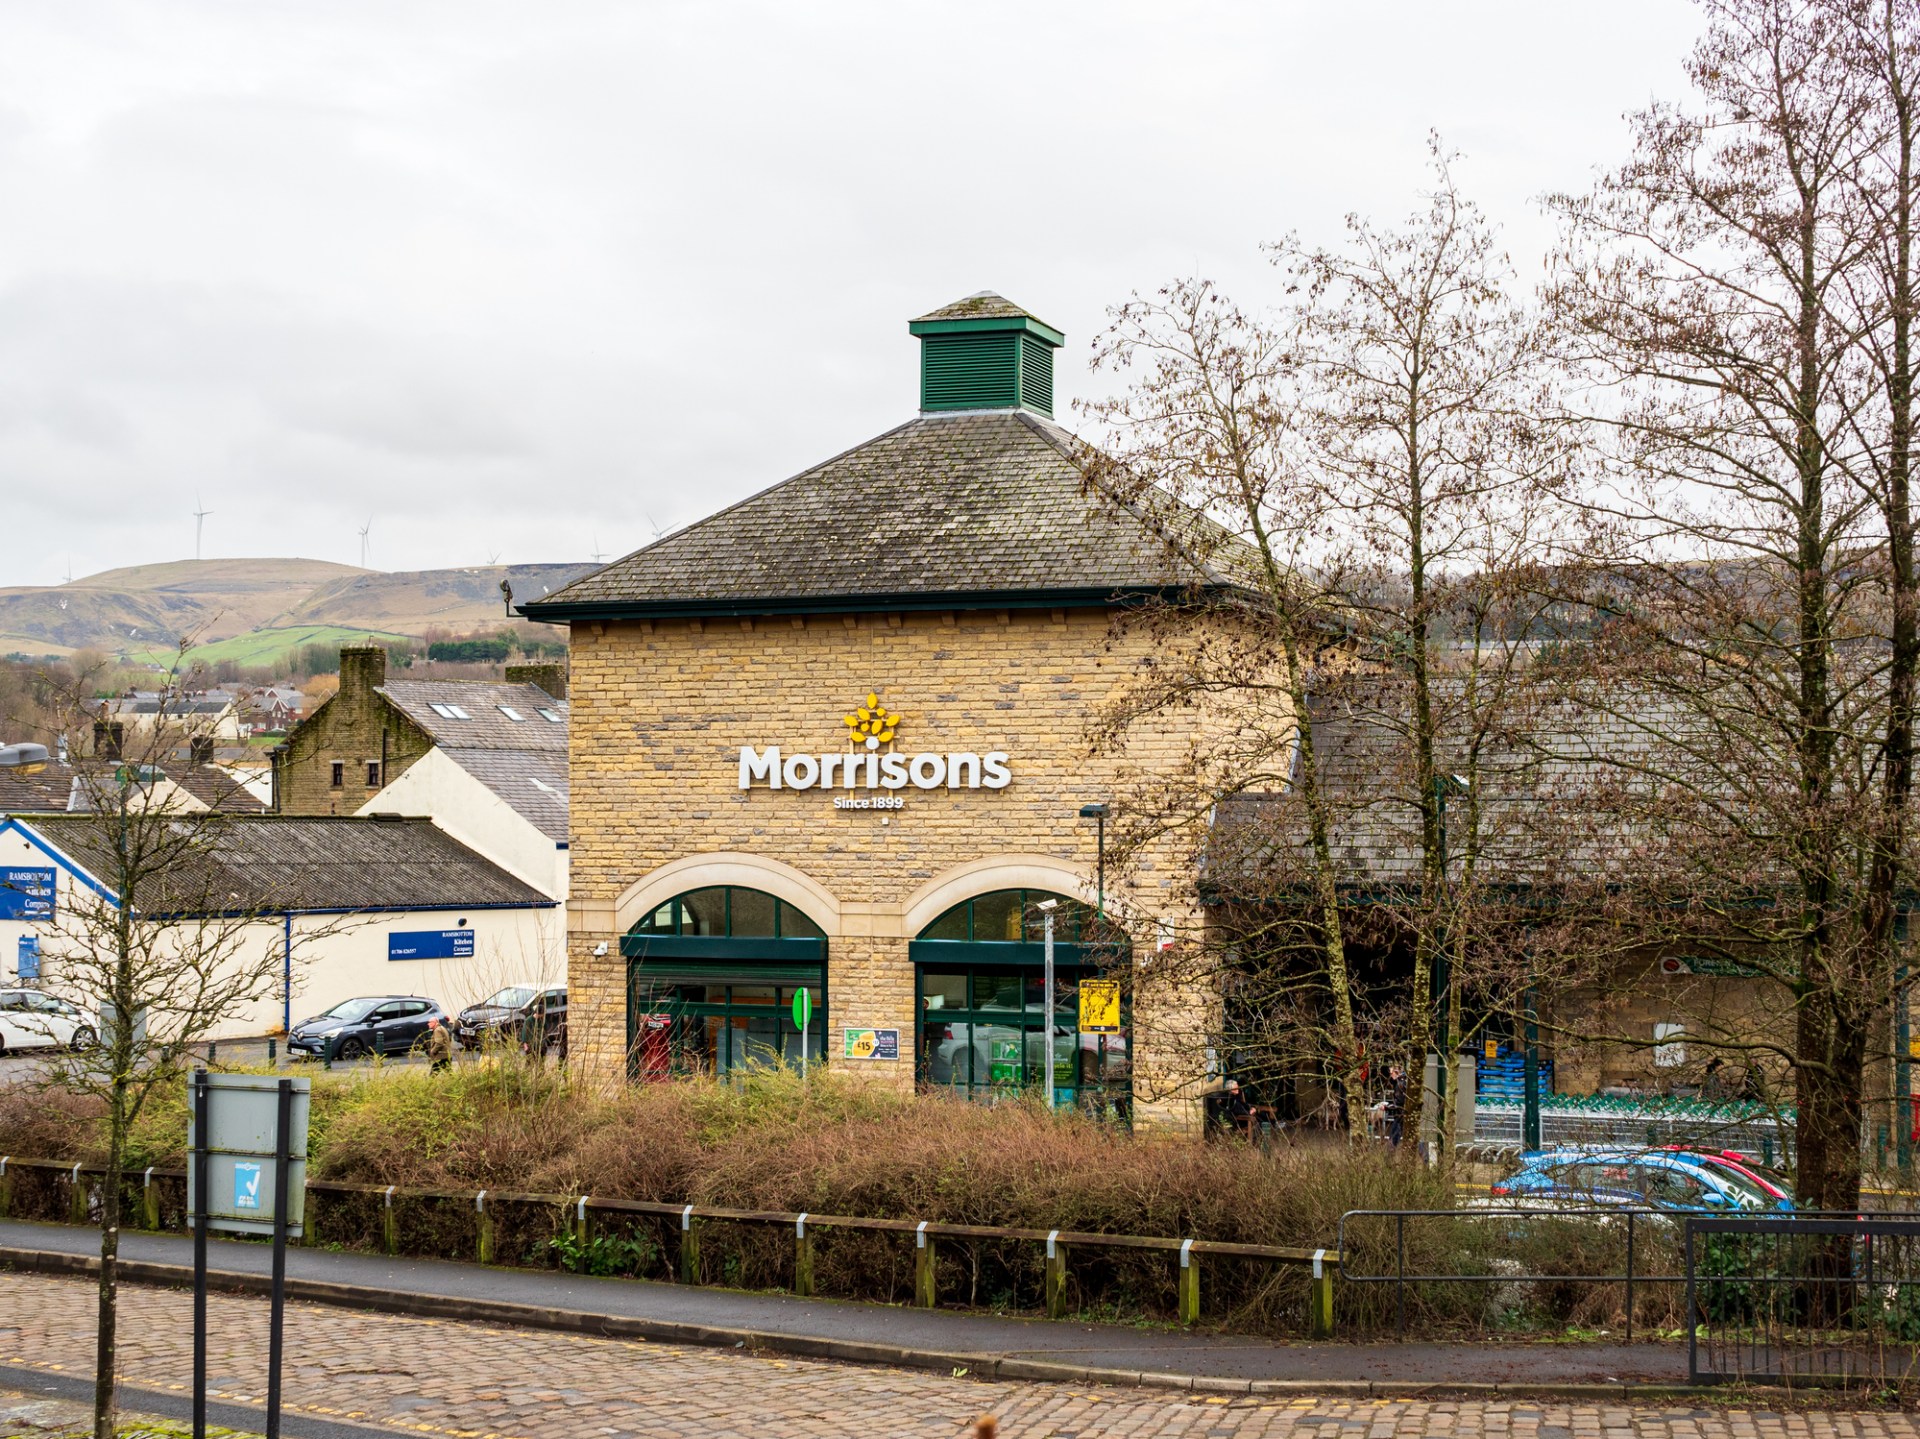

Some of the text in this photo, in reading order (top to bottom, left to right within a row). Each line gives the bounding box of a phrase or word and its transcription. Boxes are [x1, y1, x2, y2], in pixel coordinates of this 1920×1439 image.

[738, 737, 1012, 790] Morrisons
[833, 797, 904, 809] Since 1899
[857, 1041, 870, 1050] £15
